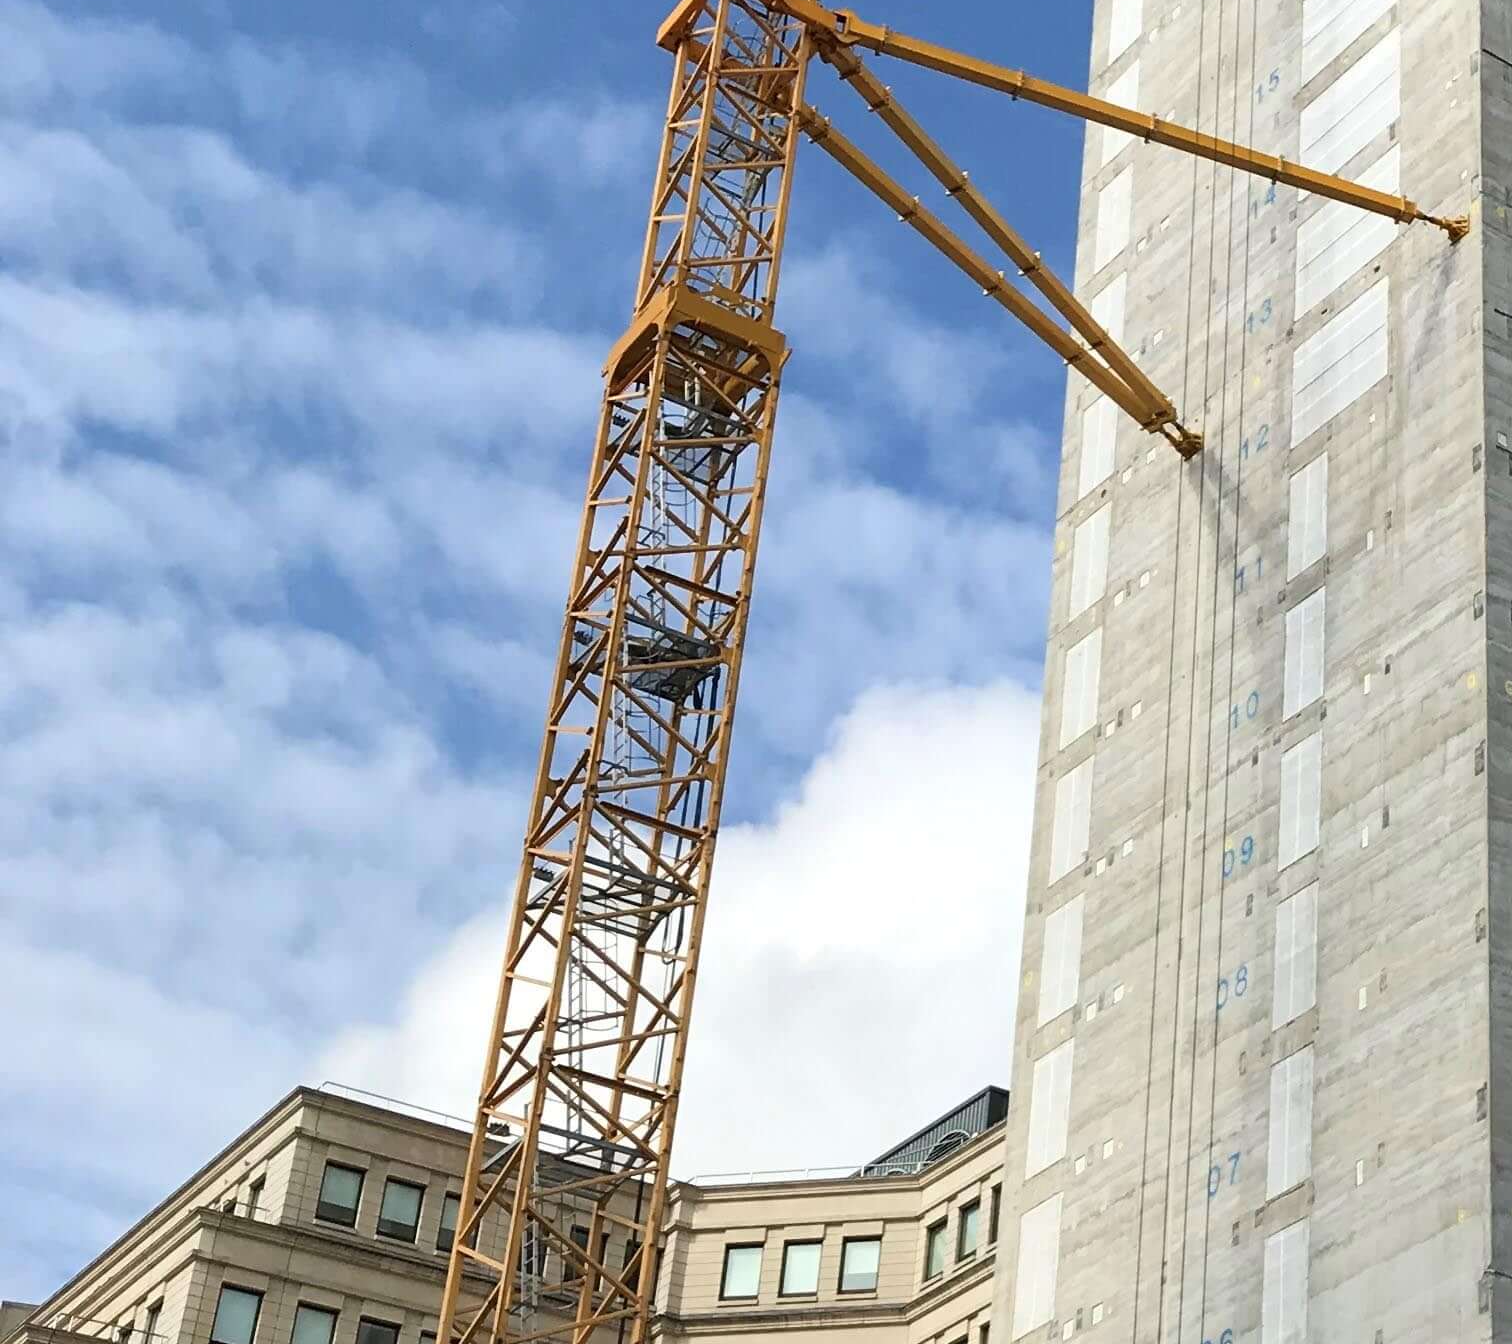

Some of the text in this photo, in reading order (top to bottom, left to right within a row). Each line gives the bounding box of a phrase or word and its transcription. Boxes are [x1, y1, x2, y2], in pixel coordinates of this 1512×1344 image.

[1255, 67, 1281, 103] 15
[1246, 298, 1273, 334] 13
[1241, 425, 1270, 459] 12
[1235, 556, 1262, 593] 11
[1231, 690, 1260, 728] 10
[1222, 835, 1254, 877] 09
[1216, 965, 1249, 1009] 08
[1208, 1152, 1240, 1197] 07
